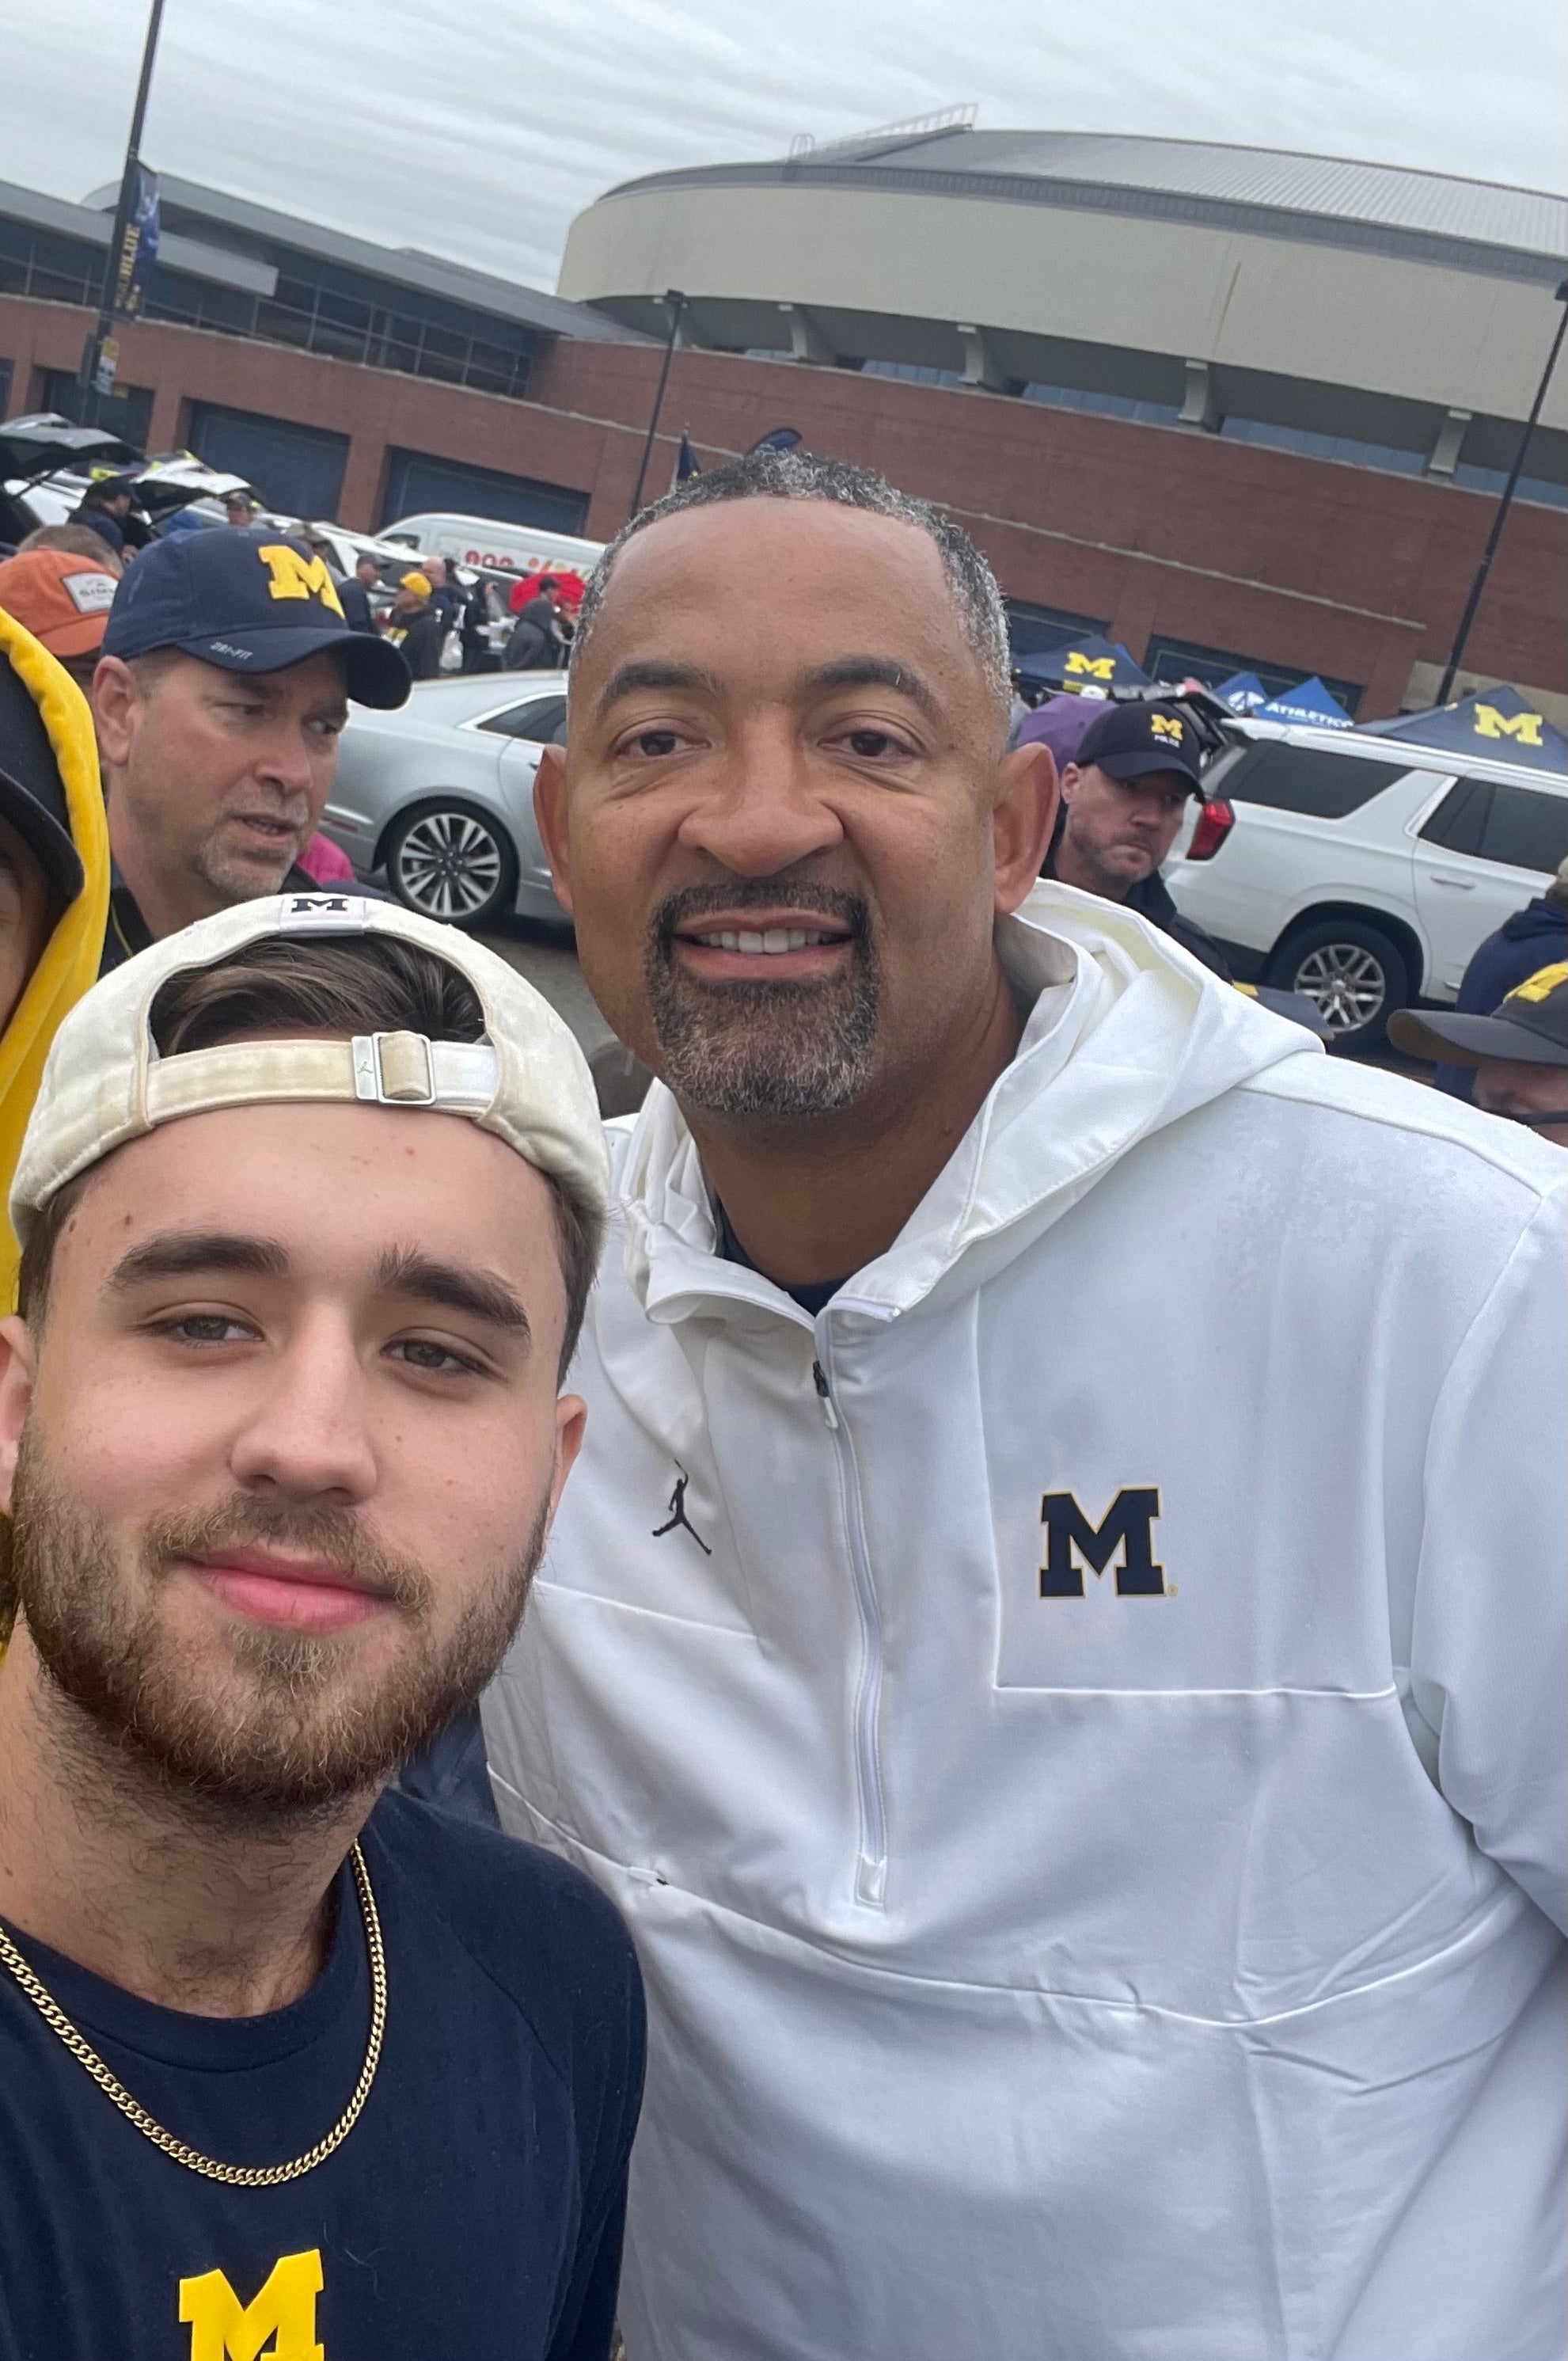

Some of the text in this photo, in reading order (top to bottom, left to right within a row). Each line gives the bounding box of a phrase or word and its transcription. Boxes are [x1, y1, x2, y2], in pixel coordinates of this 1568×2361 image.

[257, 545, 346, 620] M
[1064, 652, 1116, 679] M
[1151, 713, 1183, 741] M
[1474, 703, 1543, 747] M
[290, 898, 349, 912] M
[1039, 1485, 1166, 1599] M
[179, 2249, 325, 2361] M
